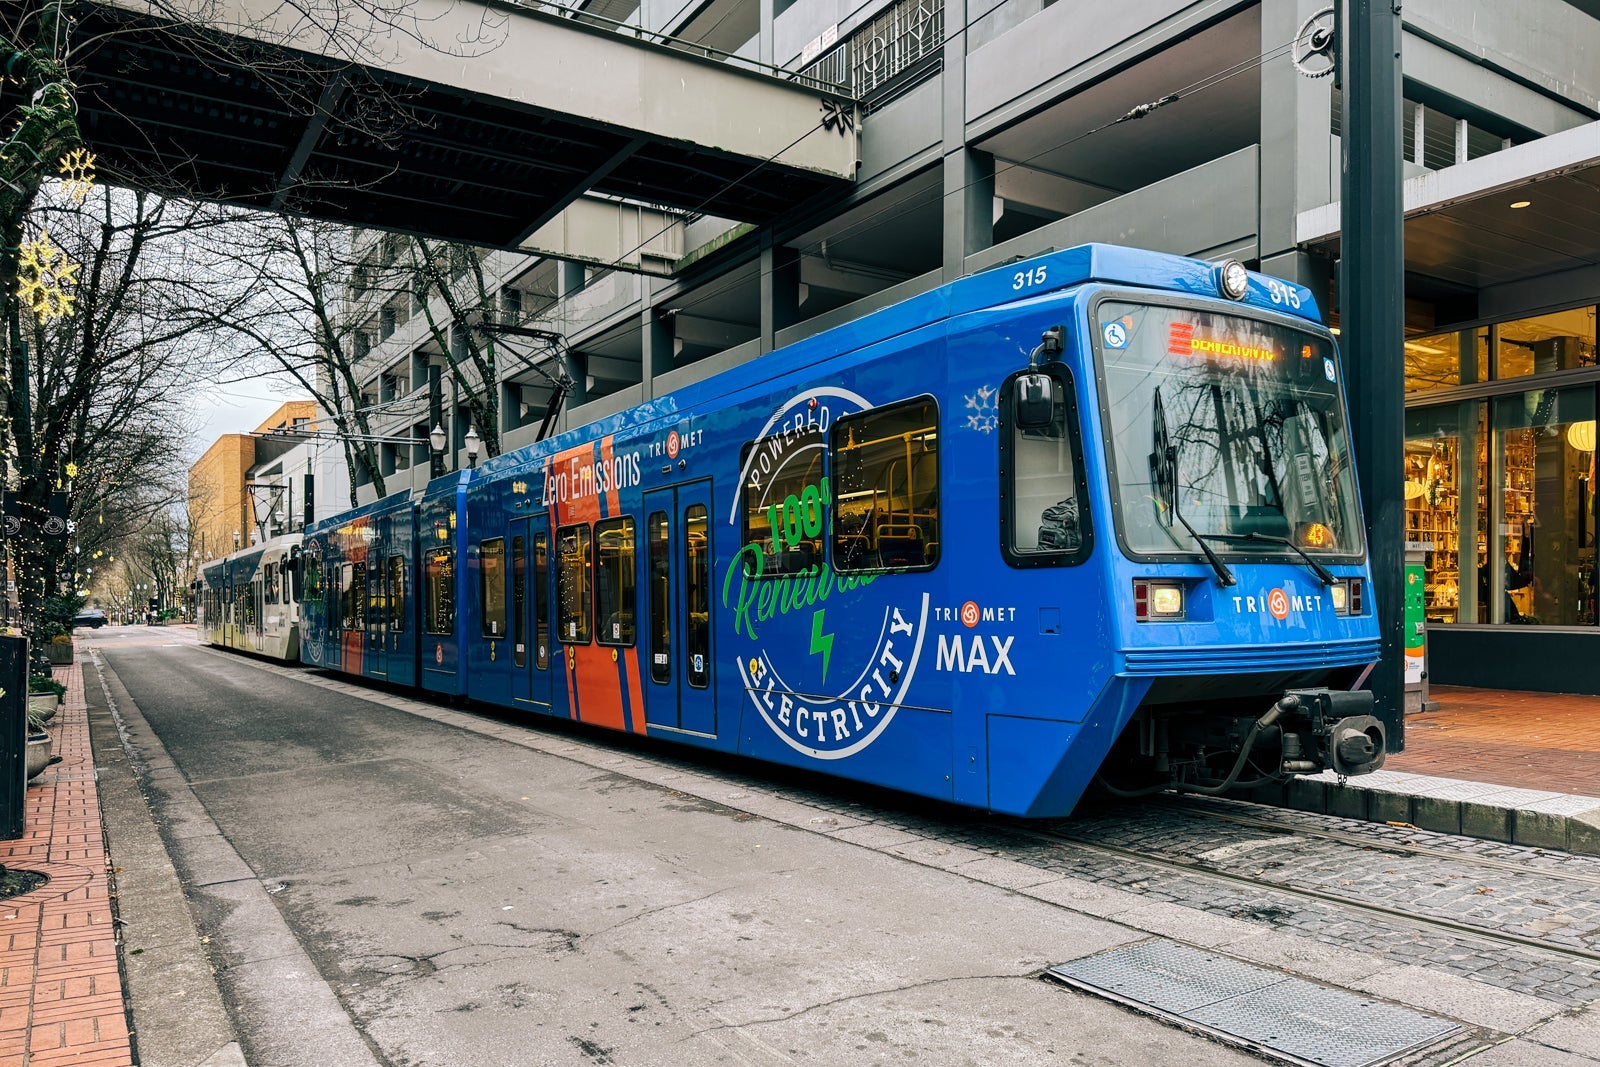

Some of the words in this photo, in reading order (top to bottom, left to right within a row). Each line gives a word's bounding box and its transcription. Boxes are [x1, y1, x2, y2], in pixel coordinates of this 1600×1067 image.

[1012, 265, 1047, 290] 315
[1268, 280, 1301, 309] 315
[751, 406, 830, 491] POWERED
[541, 467, 567, 507] Zero
[571, 447, 640, 499] Emissions
[767, 477, 833, 553] 100
[1306, 523, 1324, 545] 43
[750, 607, 913, 742] ELECTRICITY
[936, 634, 1016, 676] MAX
